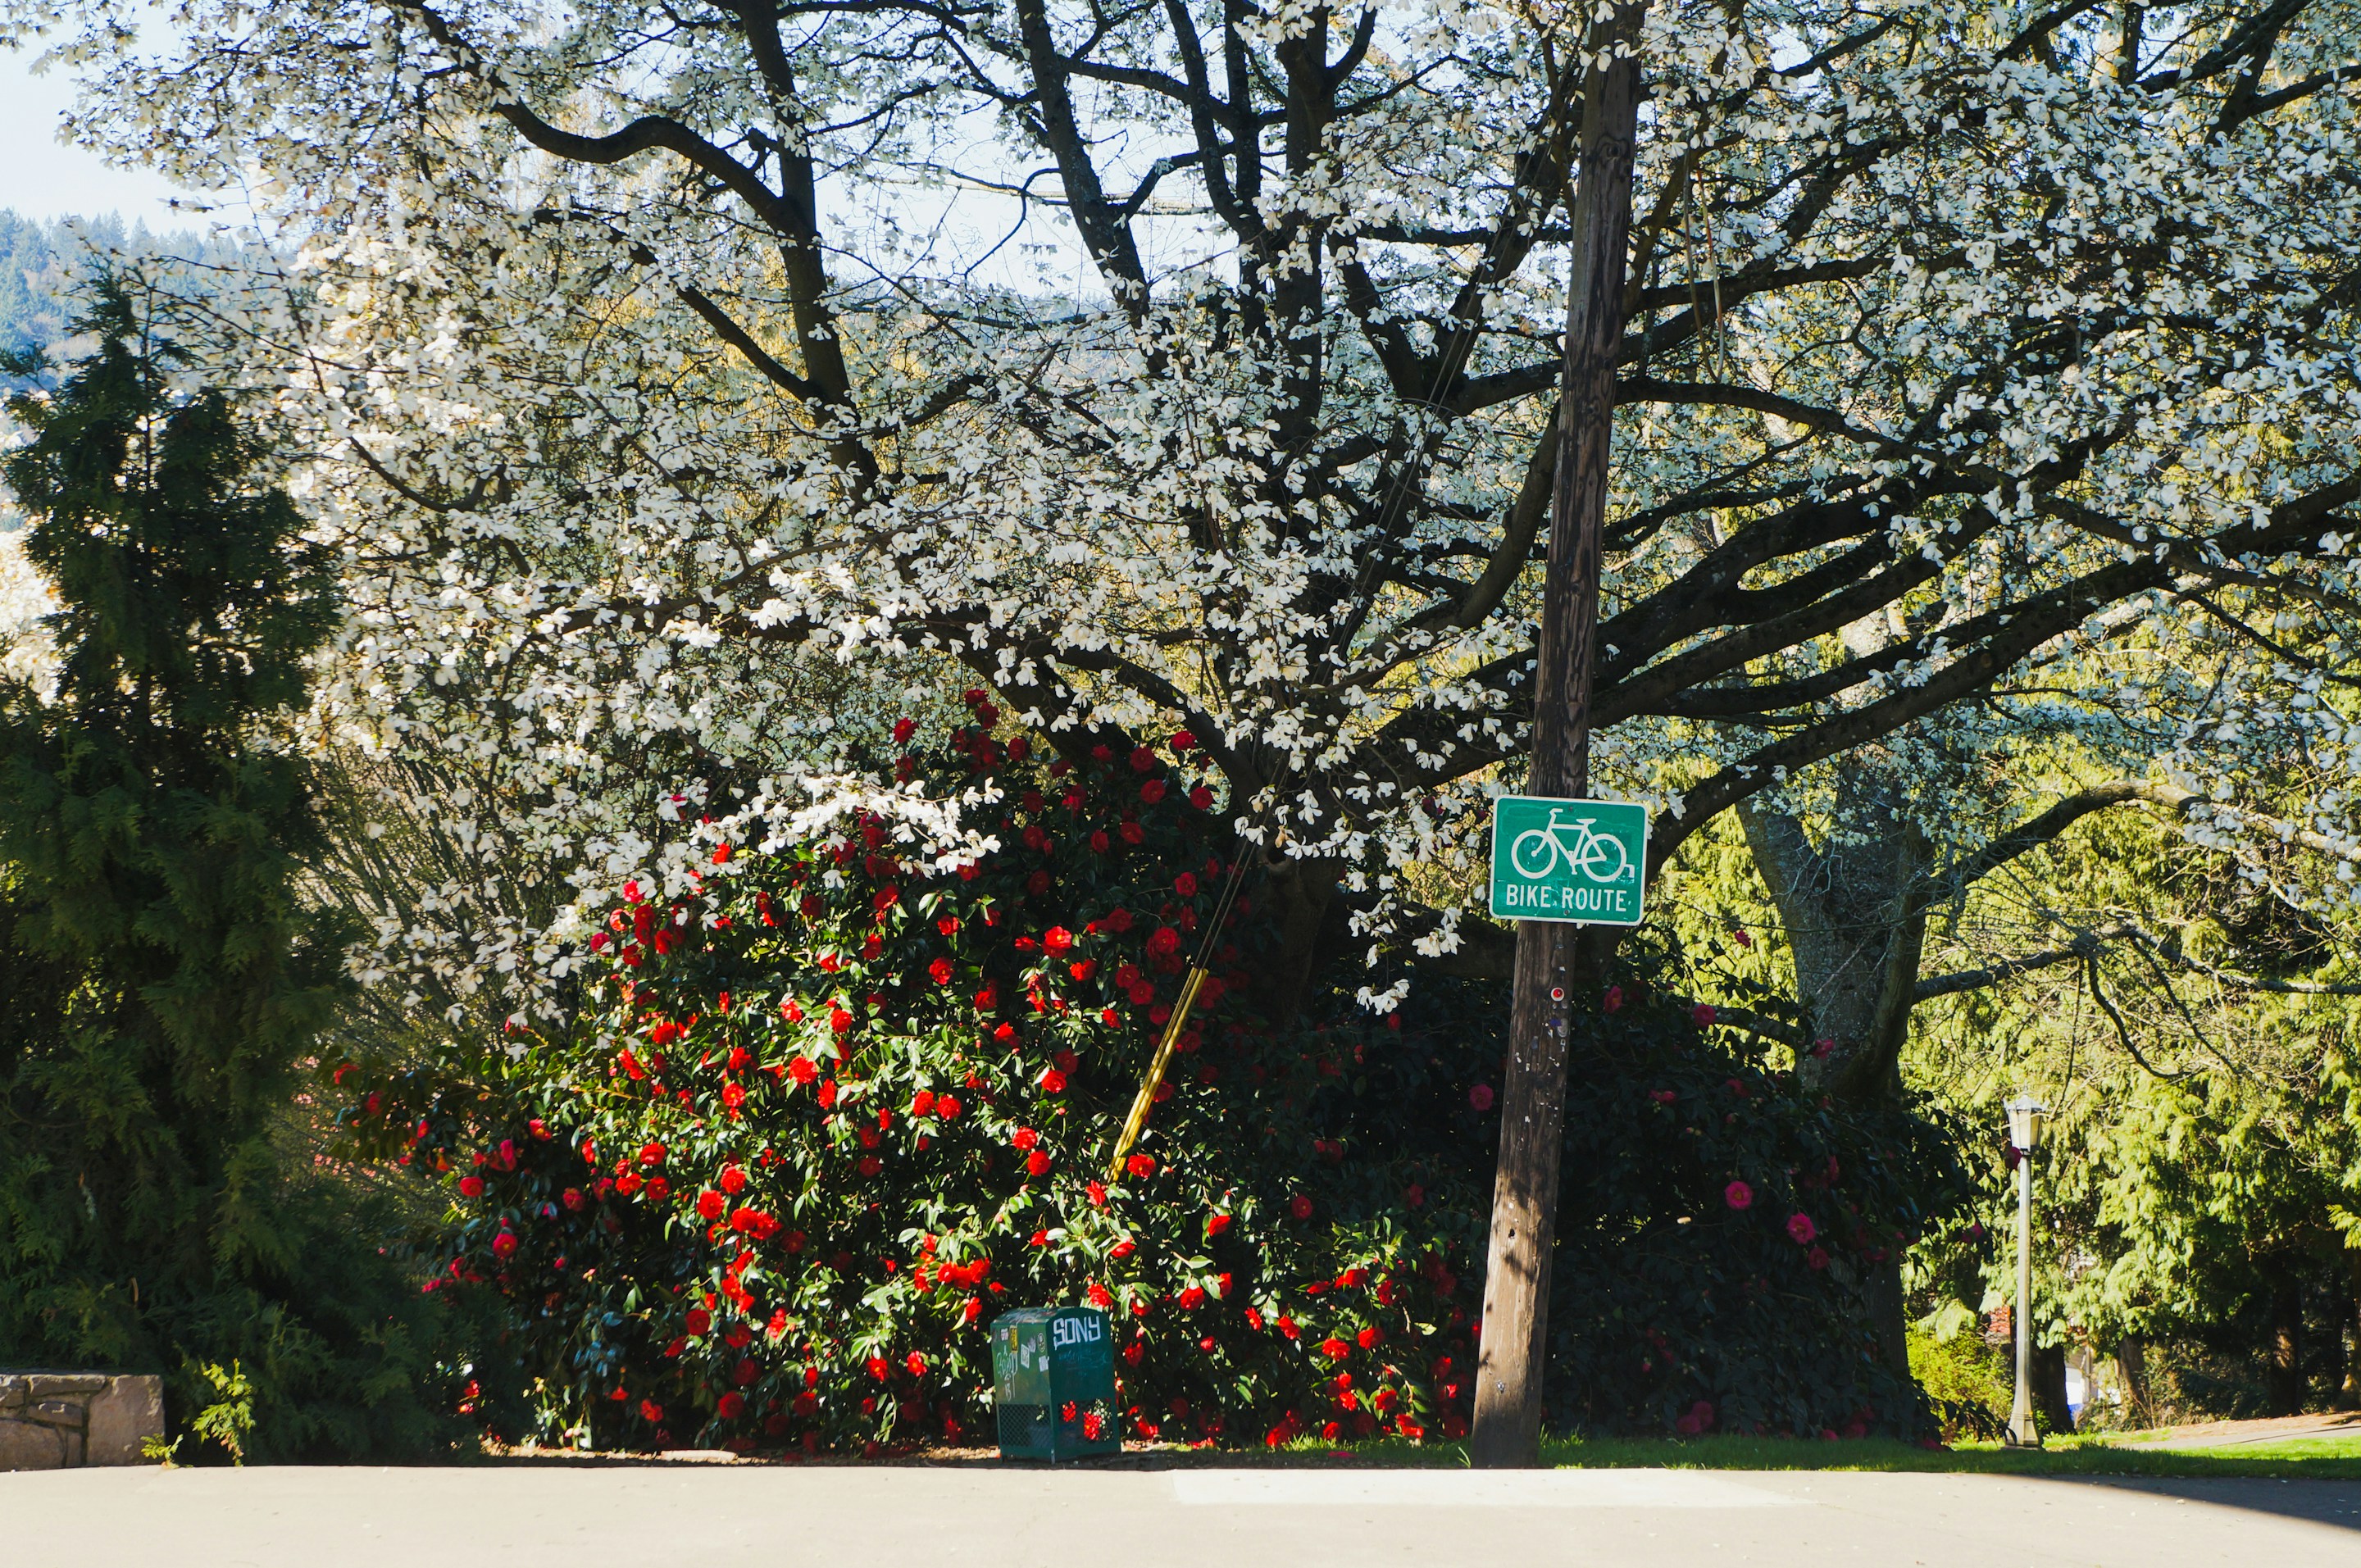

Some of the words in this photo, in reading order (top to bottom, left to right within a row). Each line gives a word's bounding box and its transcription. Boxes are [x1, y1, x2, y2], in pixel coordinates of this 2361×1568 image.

[1506, 884, 1552, 907] BIKE
[1562, 888, 1627, 911] ROUTE
[1053, 1316, 1101, 1349] SONY
